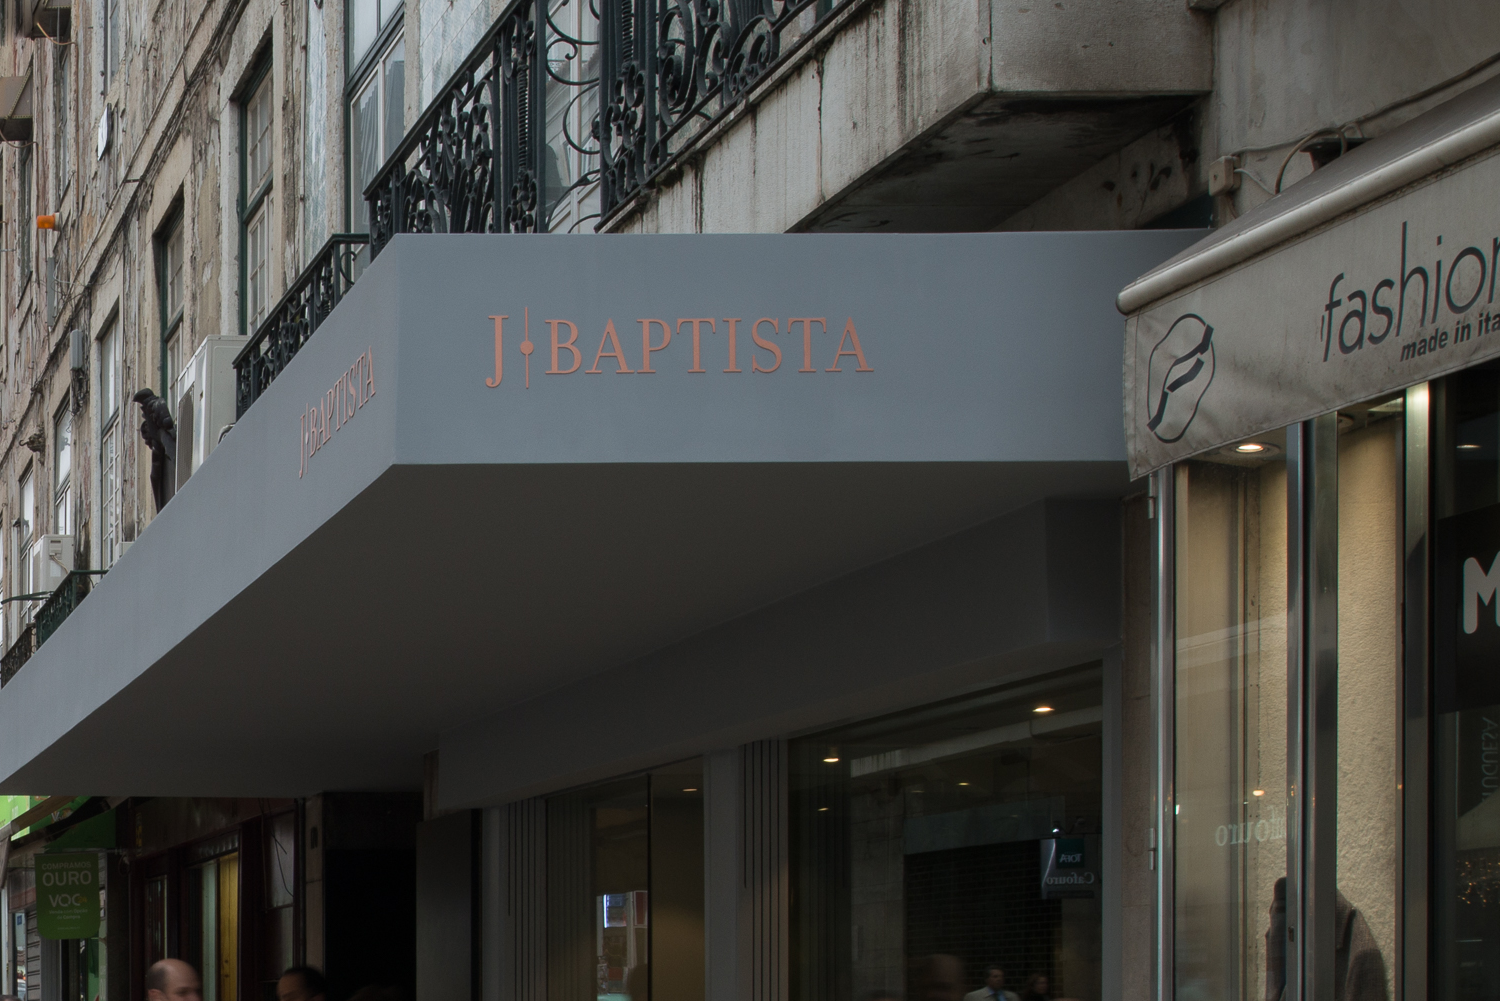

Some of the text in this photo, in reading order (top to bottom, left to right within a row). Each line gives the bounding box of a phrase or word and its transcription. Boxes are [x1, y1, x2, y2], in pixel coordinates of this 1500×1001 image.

[545, 316, 874, 375] BAPTISTA
[1400, 328, 1448, 362] made
[1454, 320, 1472, 344] in
[42, 861, 92, 870] COMPRAMOS
[42, 870, 92, 887] OURO
